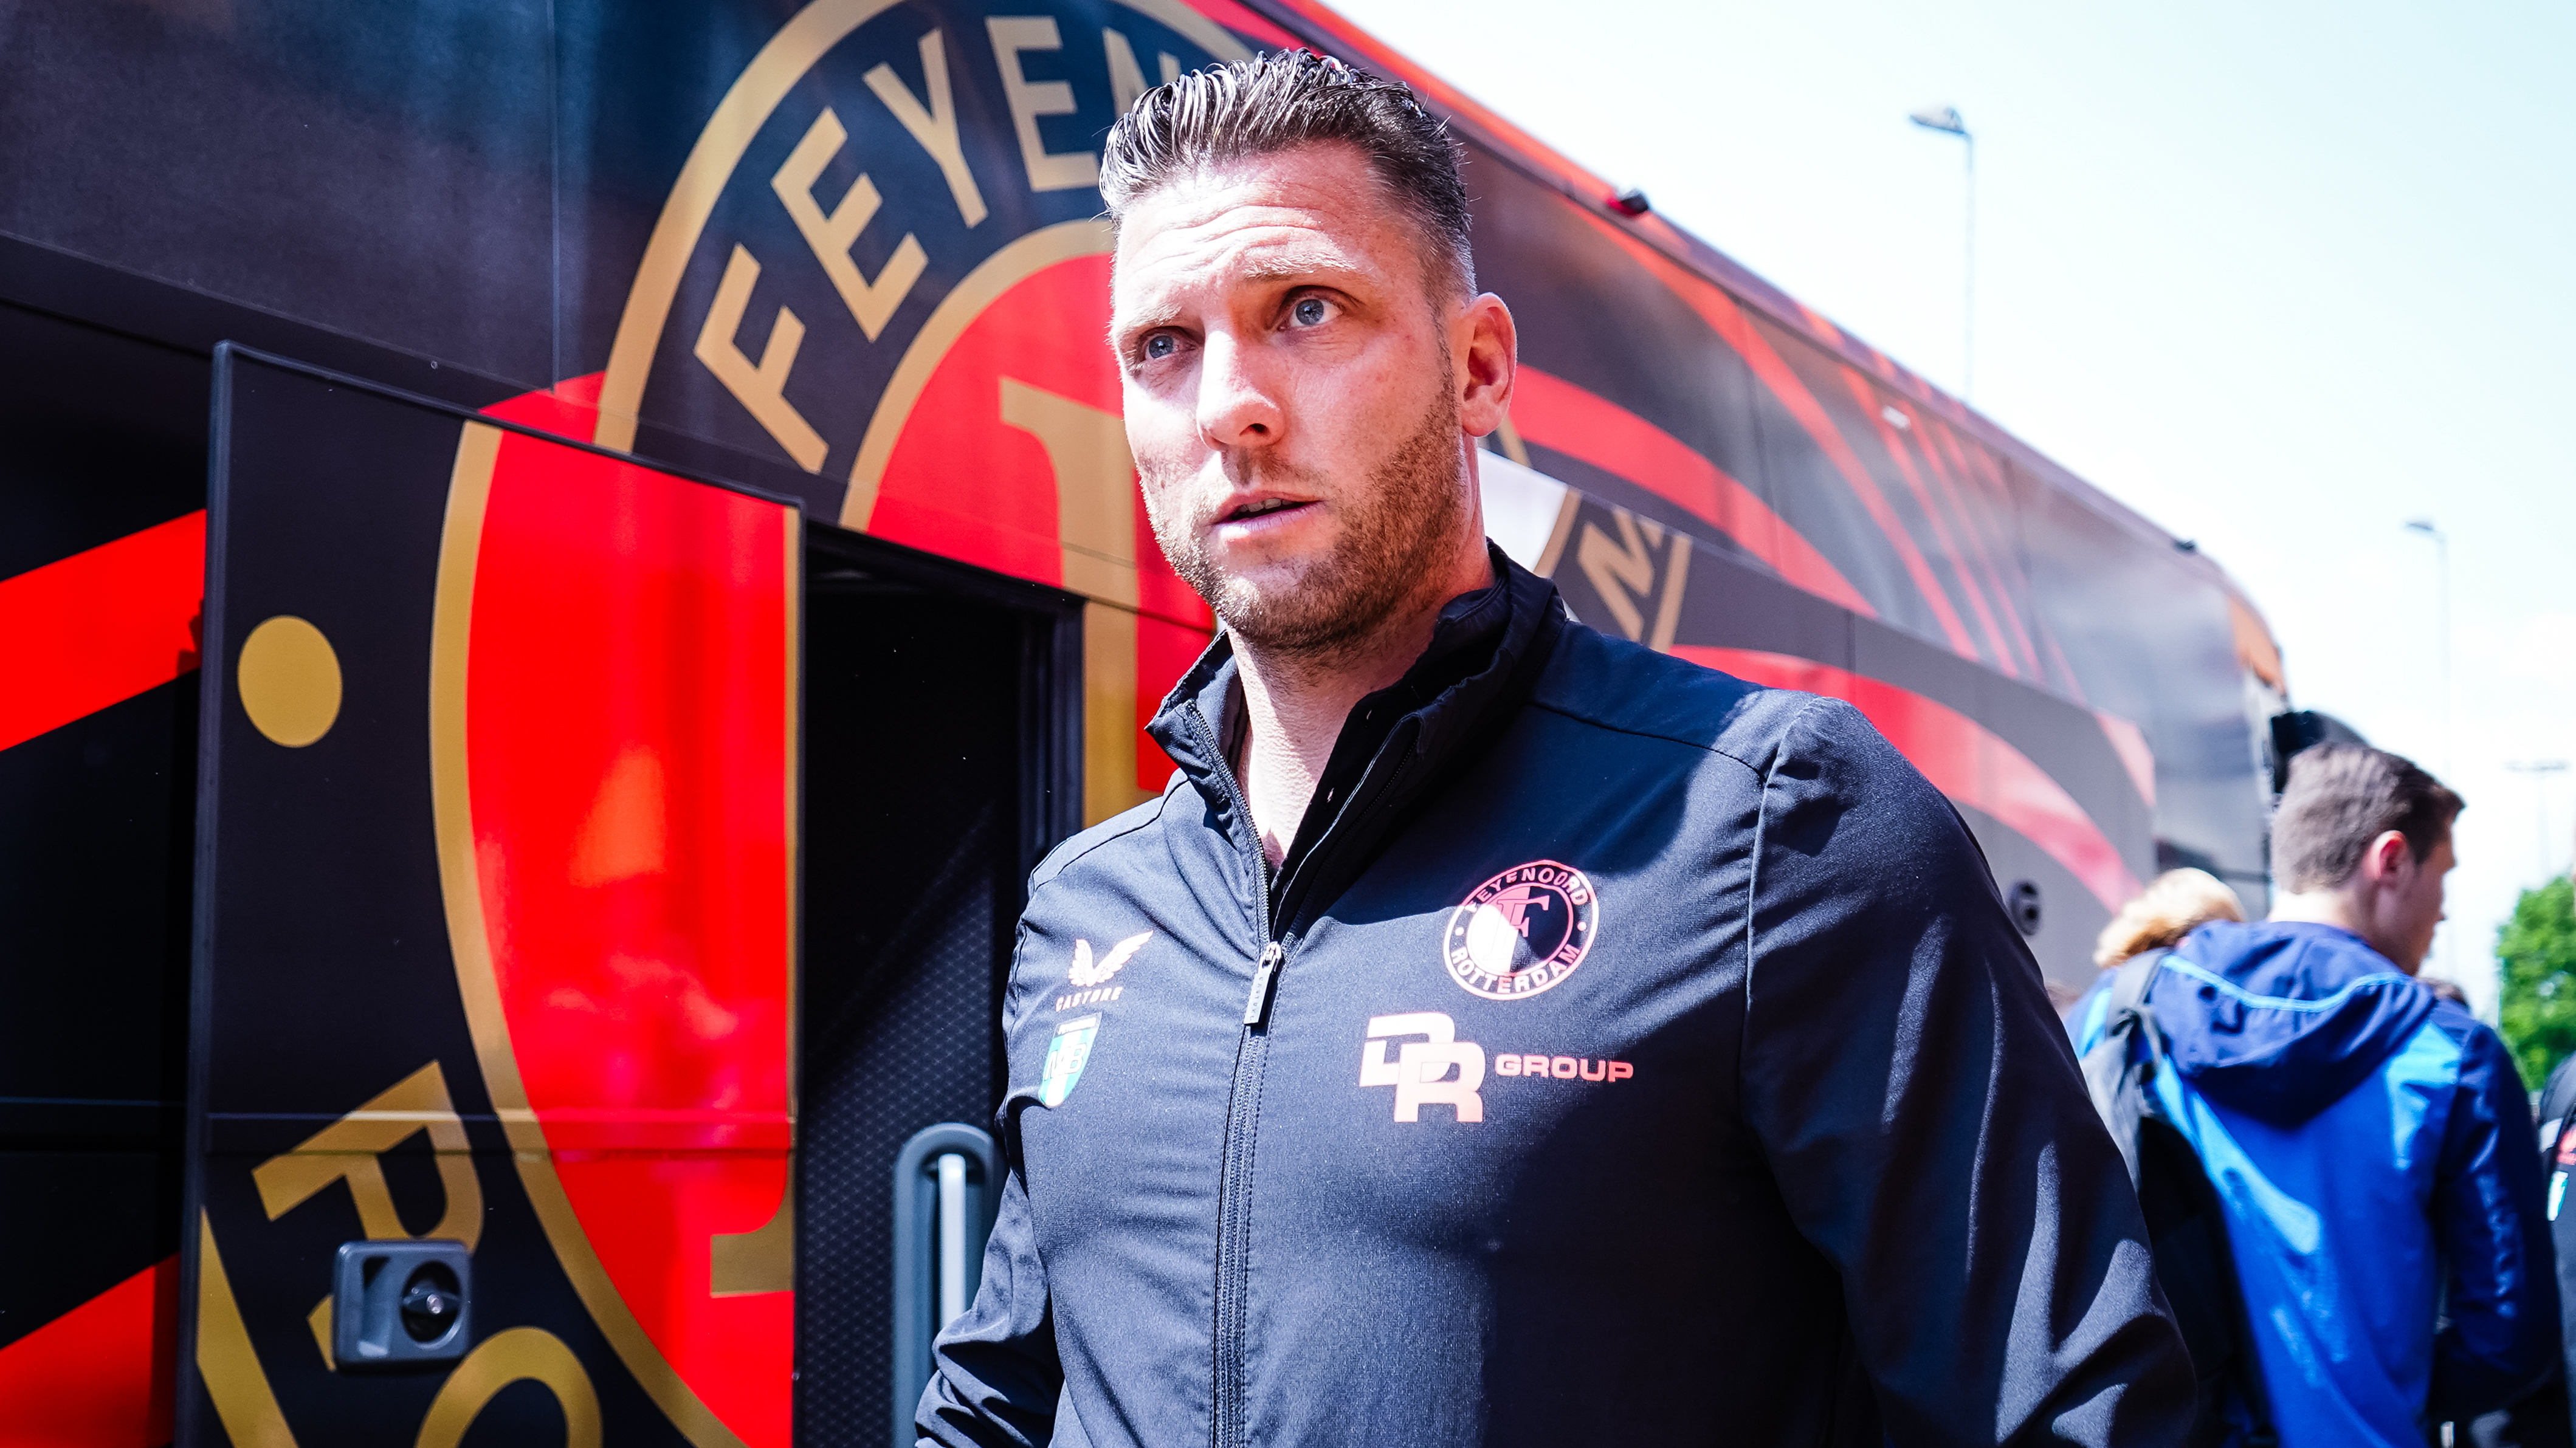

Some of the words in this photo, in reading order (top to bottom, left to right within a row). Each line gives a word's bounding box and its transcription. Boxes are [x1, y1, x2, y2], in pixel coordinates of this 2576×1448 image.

[1451, 944, 1580, 993] ROTTERDAM
[1055, 987, 1123, 1012] CASTORE
[1359, 1012, 1486, 1122] DR
[1495, 1054, 1633, 1082] GROUP
